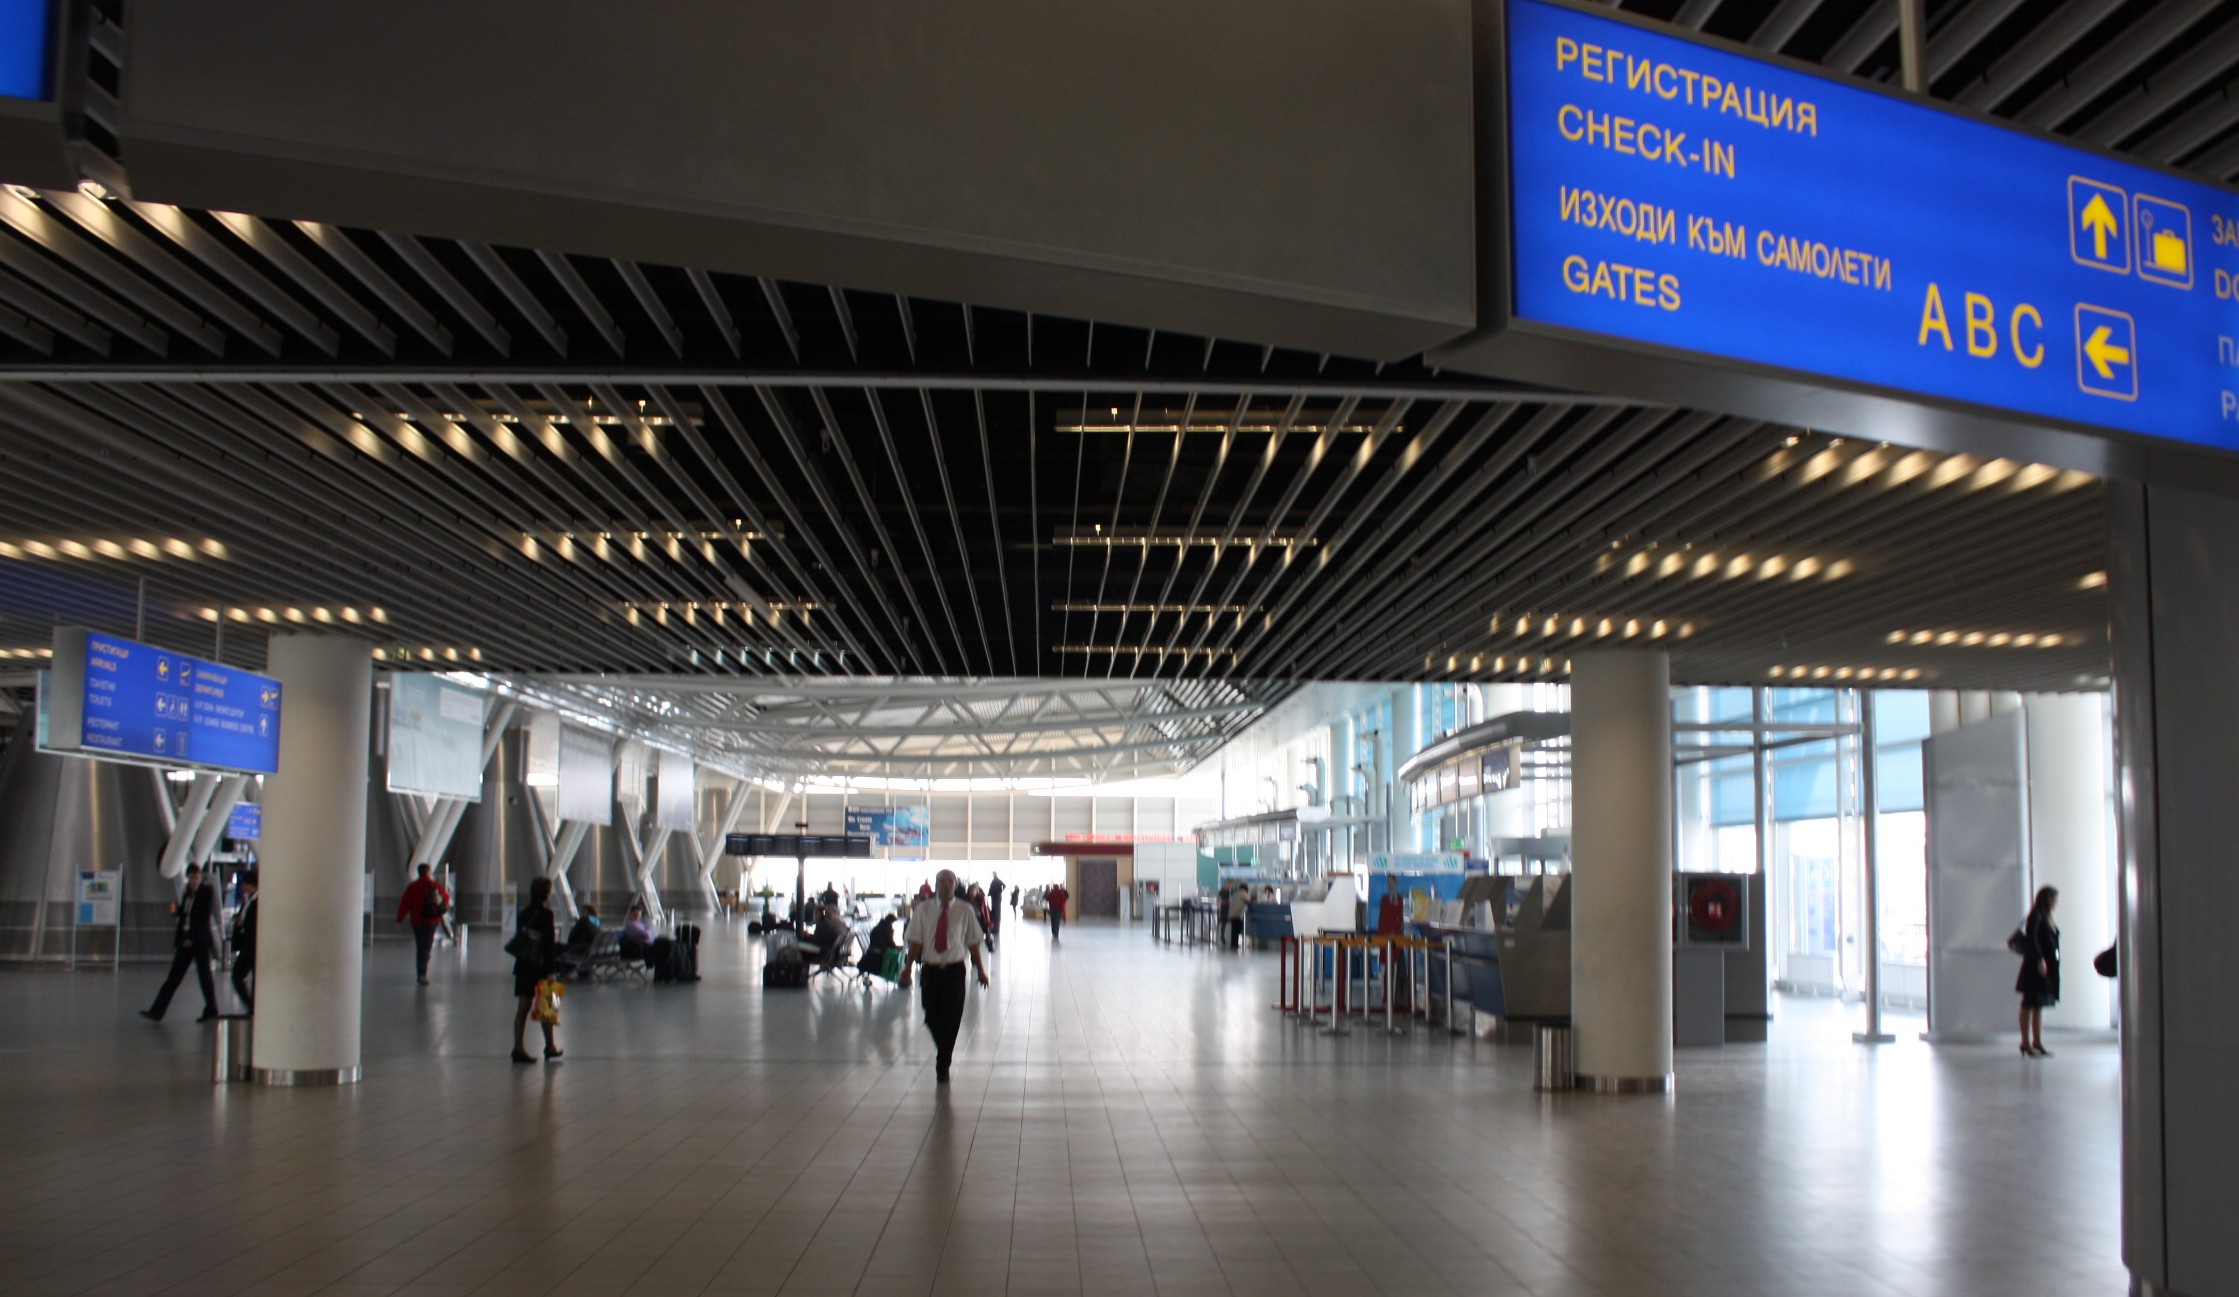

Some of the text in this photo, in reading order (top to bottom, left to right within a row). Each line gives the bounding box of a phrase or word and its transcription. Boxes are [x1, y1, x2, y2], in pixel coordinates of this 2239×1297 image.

[1556, 36, 1818, 137] РЕГИСТРАЦИЯ
[1557, 104, 1736, 179] CHECK-IN
[1560, 184, 1892, 292] ИЗХОДИ КЪМ САМОЛЕТИ
[1562, 254, 1682, 311] GATES
[1918, 282, 2045, 369] A B C
